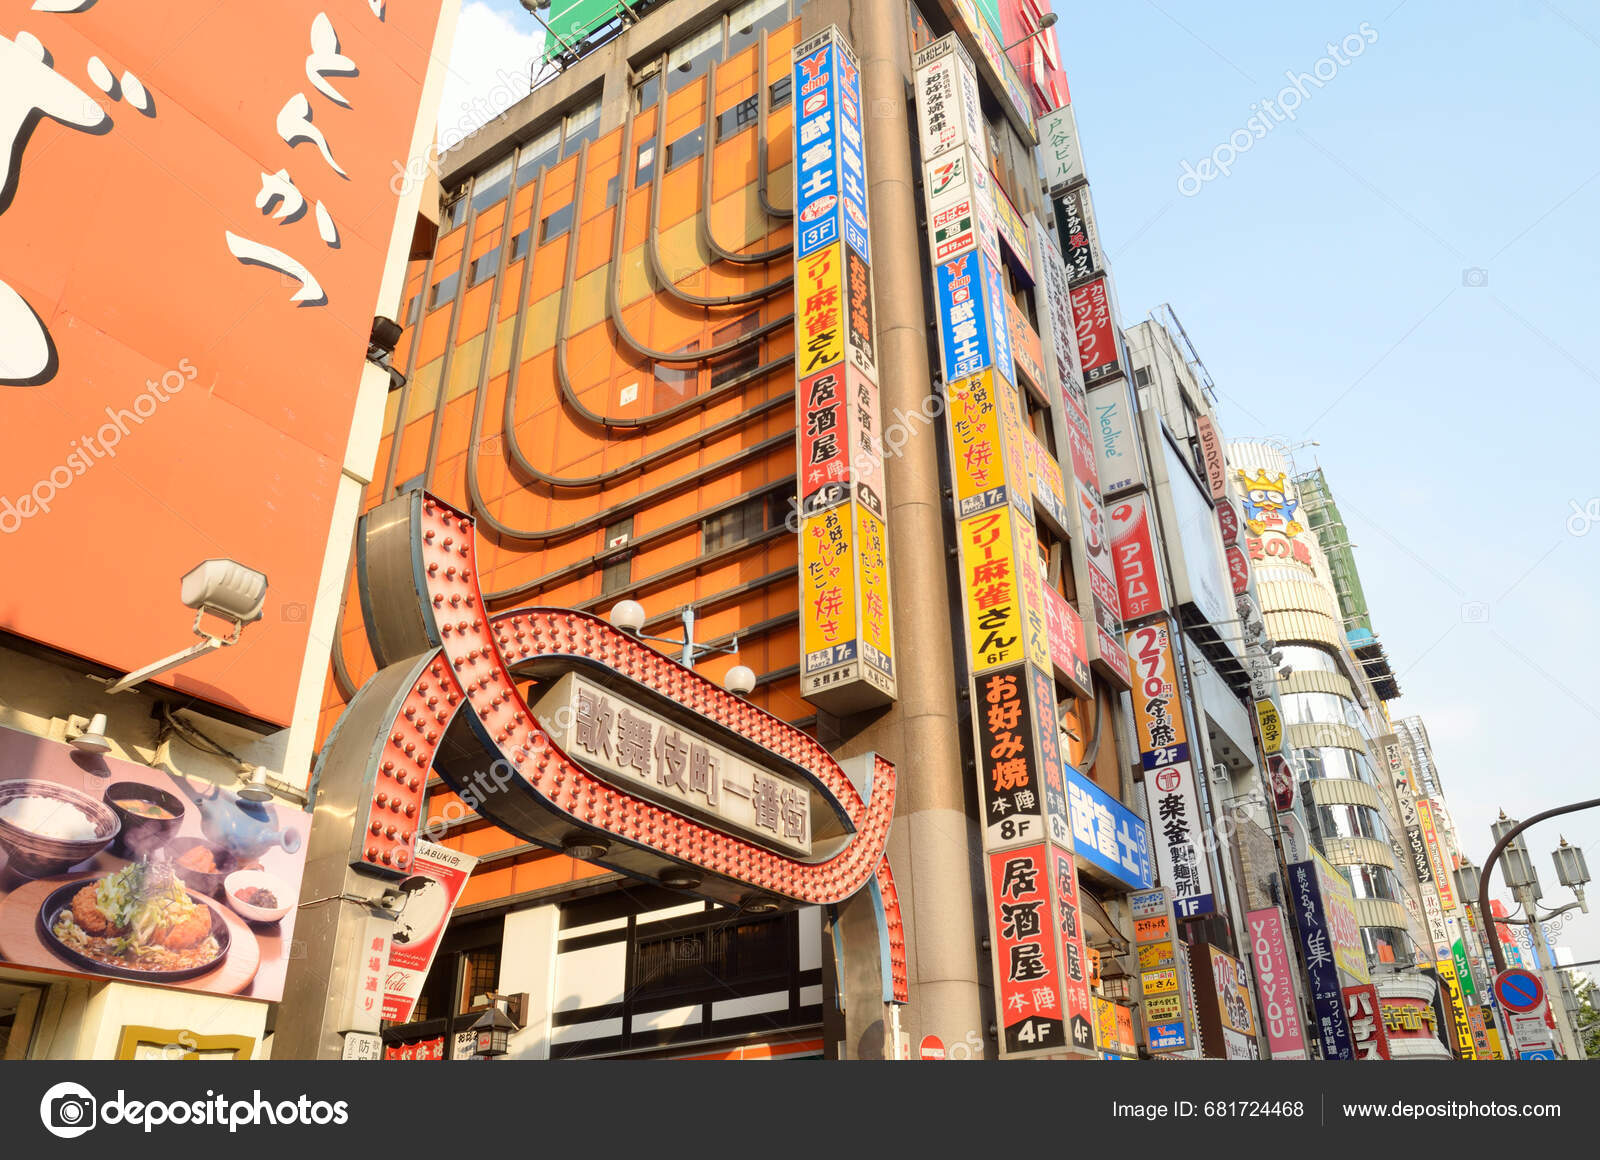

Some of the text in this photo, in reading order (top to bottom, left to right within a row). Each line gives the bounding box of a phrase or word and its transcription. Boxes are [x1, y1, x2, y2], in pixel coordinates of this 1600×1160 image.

[918, 40, 950, 65] 小松ビル
[801, 72, 829, 96] shop
[800, 110, 833, 198] 武富士
[841, 113, 863, 205] 武富士
[1047, 118, 1073, 177] 戸谷ビル
[808, 222, 832, 245] 3F
[849, 227, 864, 249] 3F
[805, 249, 840, 371] フリー麻雀さん
[850, 255, 870, 341] お好み焼
[1091, 284, 1108, 328] カラオケ
[950, 300, 979, 361] 武富士
[1072, 288, 1099, 368] ビックワン
[855, 350, 870, 372] 8F
[958, 359, 979, 374] 3F
[1090, 361, 1112, 381] 5F
[958, 391, 987, 433] もんじゃ
[969, 379, 993, 414] お好み
[807, 374, 841, 466] 居酒屋
[857, 383, 872, 456] 居酒屋
[955, 420, 974, 443] たこ
[808, 461, 845, 483] 本陣
[964, 440, 993, 487] 焼き
[812, 487, 839, 507] 4F
[861, 486, 878, 510] 4F
[987, 489, 1003, 504] 7F
[812, 526, 840, 578] もんじゃ
[824, 514, 848, 556] お好み
[808, 561, 827, 589] たこ
[968, 513, 1017, 654] フリー麻雀さん
[1120, 542, 1148, 597] アコム
[813, 586, 843, 642] 焼き
[865, 589, 882, 645] 焼き
[1130, 599, 1150, 615] 3F
[836, 644, 852, 660] 7F
[879, 655, 889, 671] 7F
[987, 650, 1009, 664] 6F
[1076, 660, 1088, 684] 4F
[986, 674, 1030, 792] お好み焼
[1036, 673, 1062, 792] お好み焼
[1146, 698, 1175, 748] 金の蔵
[1263, 714, 1279, 740] 虎の子
[576, 687, 807, 844] 歌舞伎町一番街
[1154, 748, 1177, 766] 2F
[992, 789, 1035, 815] 本陣
[1000, 819, 1030, 840] 8F
[1052, 815, 1066, 841] 8F
[1068, 780, 1140, 876] 武富士
[1137, 825, 1149, 884] 3F
[1002, 857, 1048, 982] 居酒屋
[1057, 856, 1083, 982] 居酒屋
[1178, 898, 1199, 918] 1F
[365, 937, 384, 1011] 劇場通り
[1456, 954, 1468, 977] レイク
[1008, 986, 1055, 1012] 本陣
[1018, 1020, 1051, 1043] 4F
[1074, 1019, 1088, 1043] 4F
[1329, 1000, 1346, 1037] ワインと
